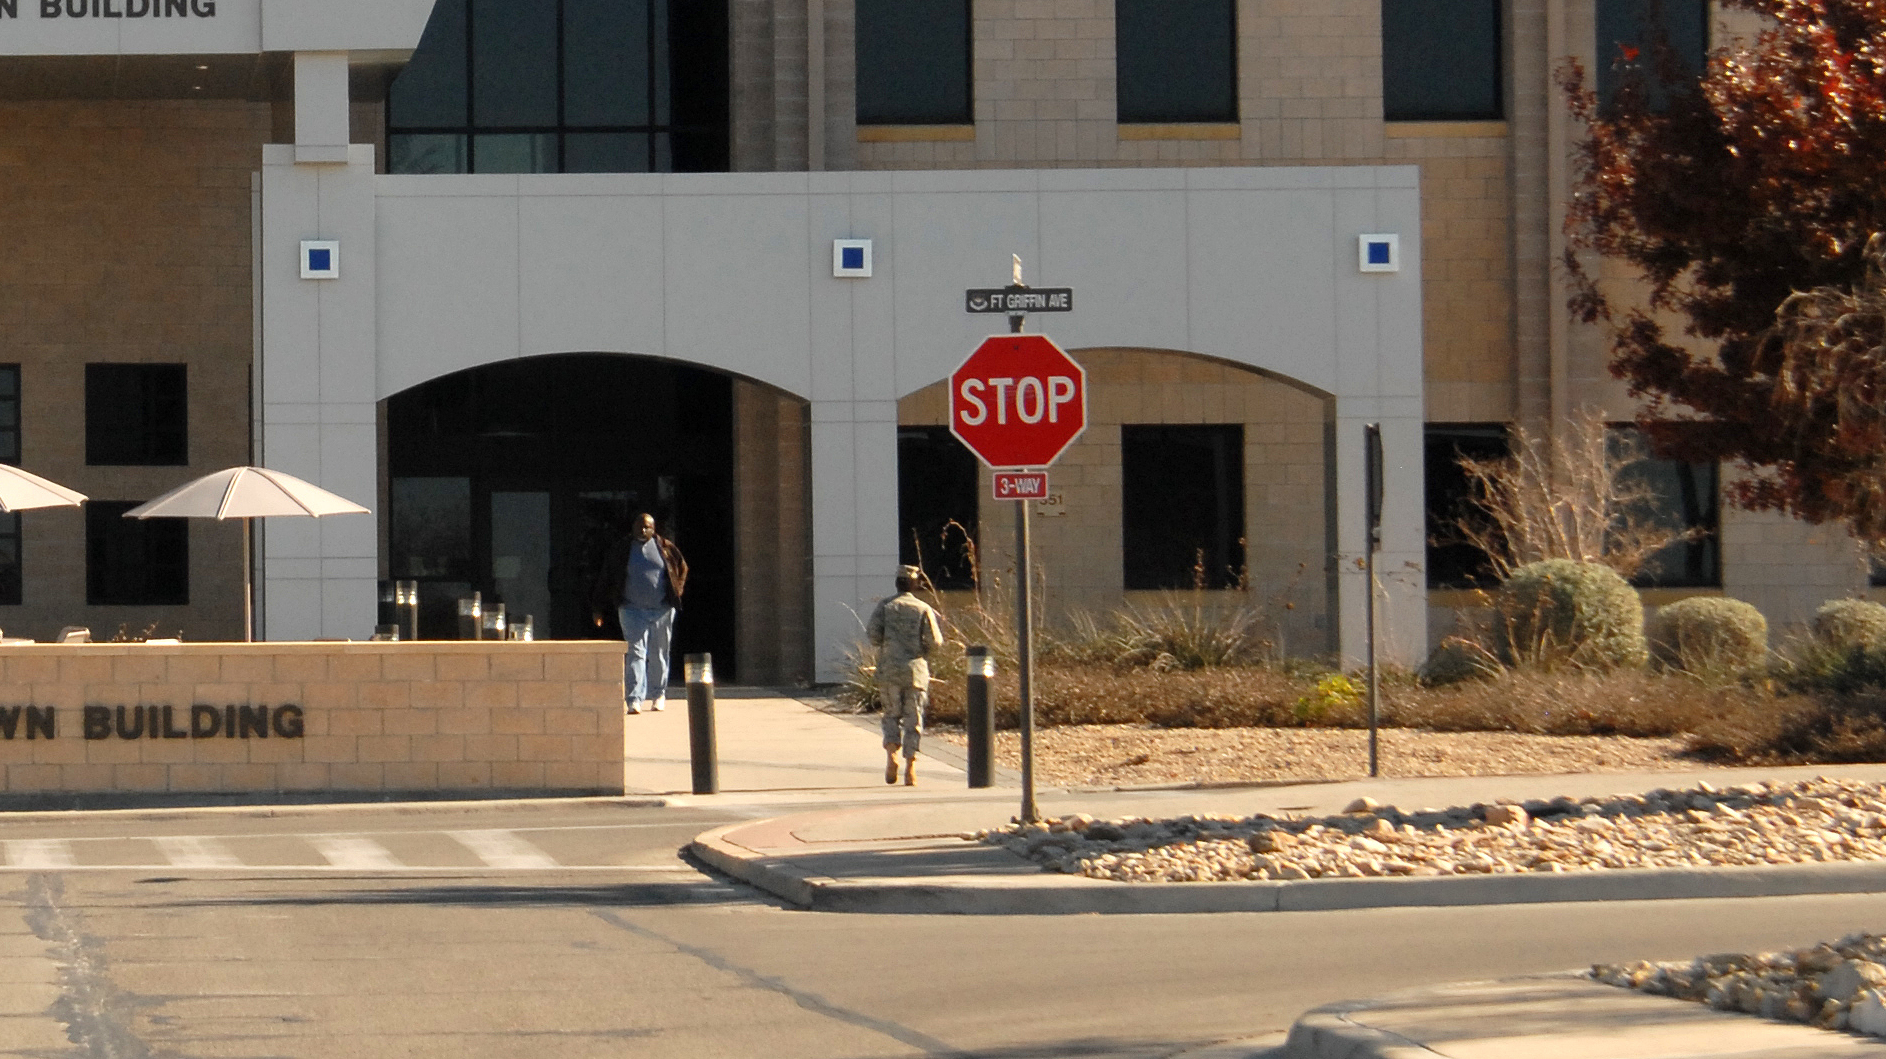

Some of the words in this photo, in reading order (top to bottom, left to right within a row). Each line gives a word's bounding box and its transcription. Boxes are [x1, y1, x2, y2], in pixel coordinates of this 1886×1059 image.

[990, 294, 1004, 309] FT
[1006, 294, 1045, 309] GRIFFIN
[1048, 293, 1068, 308] AVE
[960, 376, 1075, 425] STOP
[1000, 477, 1040, 494] 3-WAY
[83, 703, 305, 740] BUILDING
